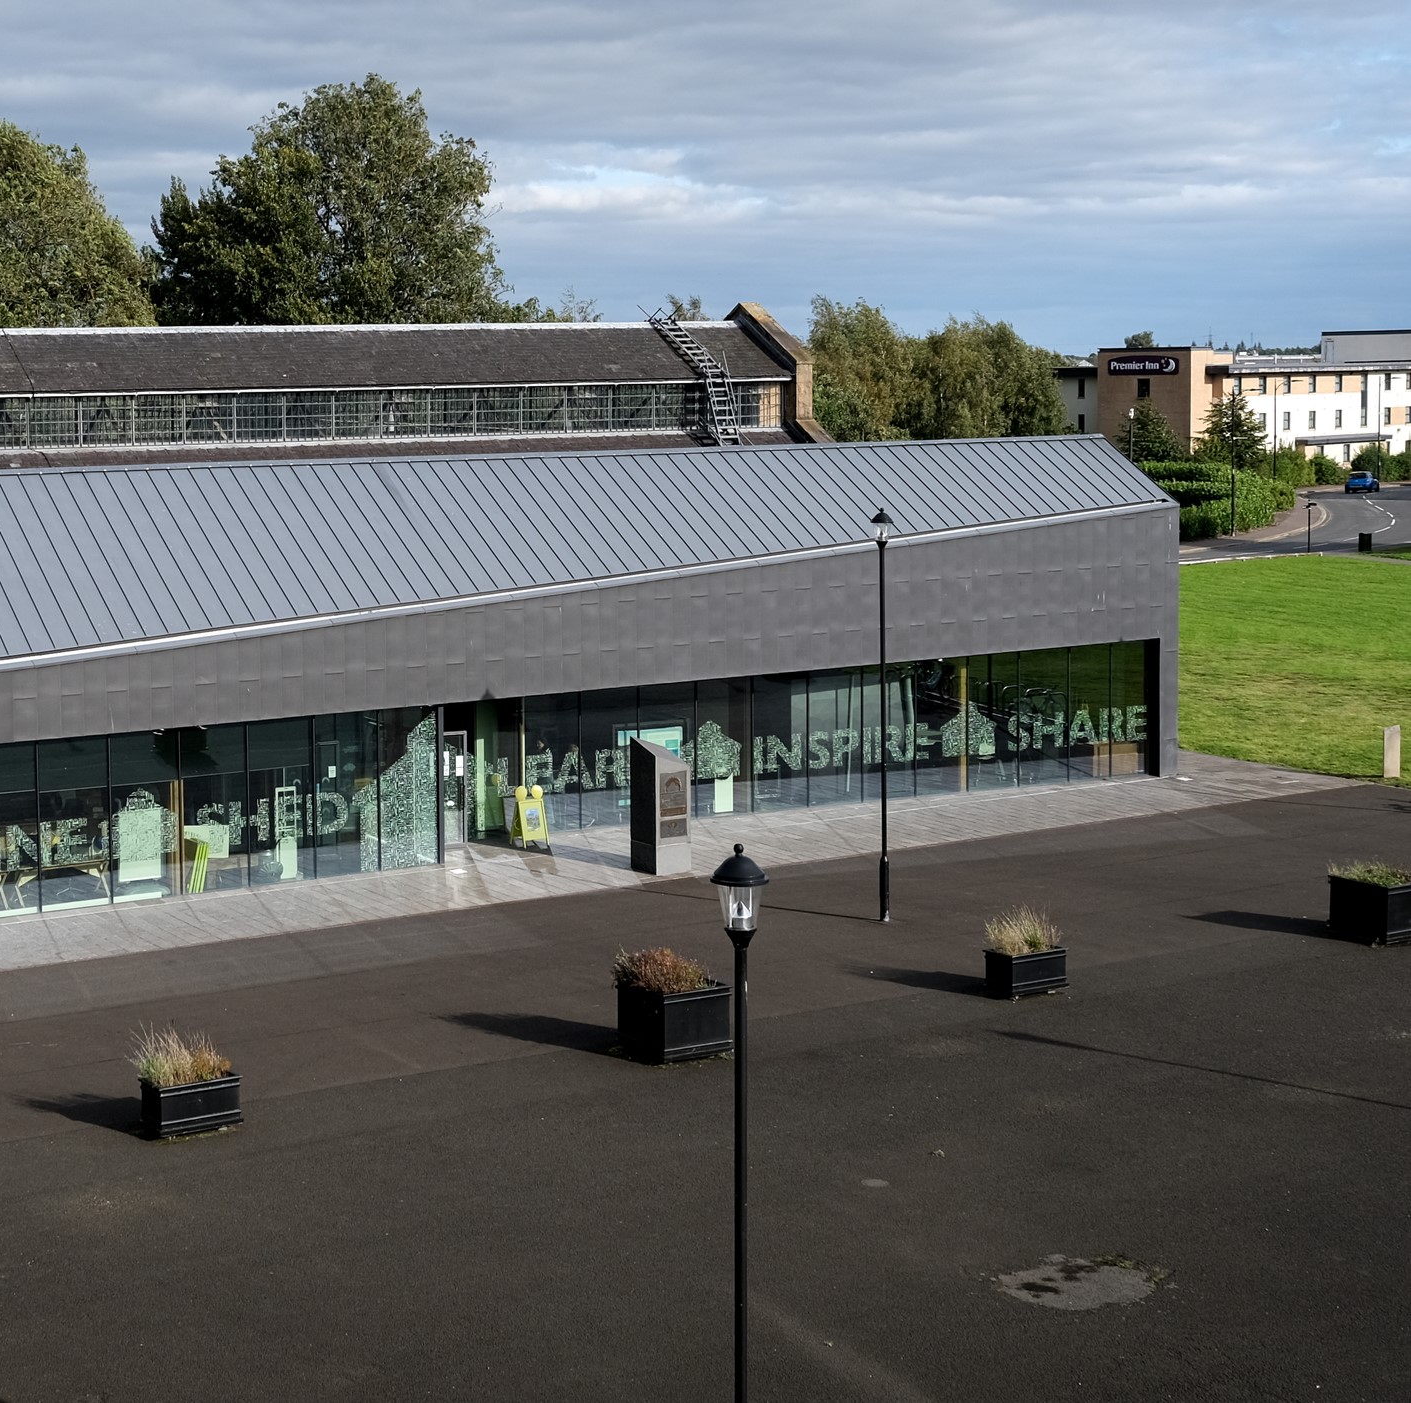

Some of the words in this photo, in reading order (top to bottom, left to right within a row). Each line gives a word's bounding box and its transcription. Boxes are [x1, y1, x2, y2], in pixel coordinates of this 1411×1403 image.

[1110, 361, 1144, 370] Premier
[1145, 361, 1160, 370] Inn
[496, 748, 631, 797] LEAR
[753, 722, 930, 775] INSPIRE
[1007, 704, 1148, 751] SHARE
[196, 791, 348, 853] SHED
